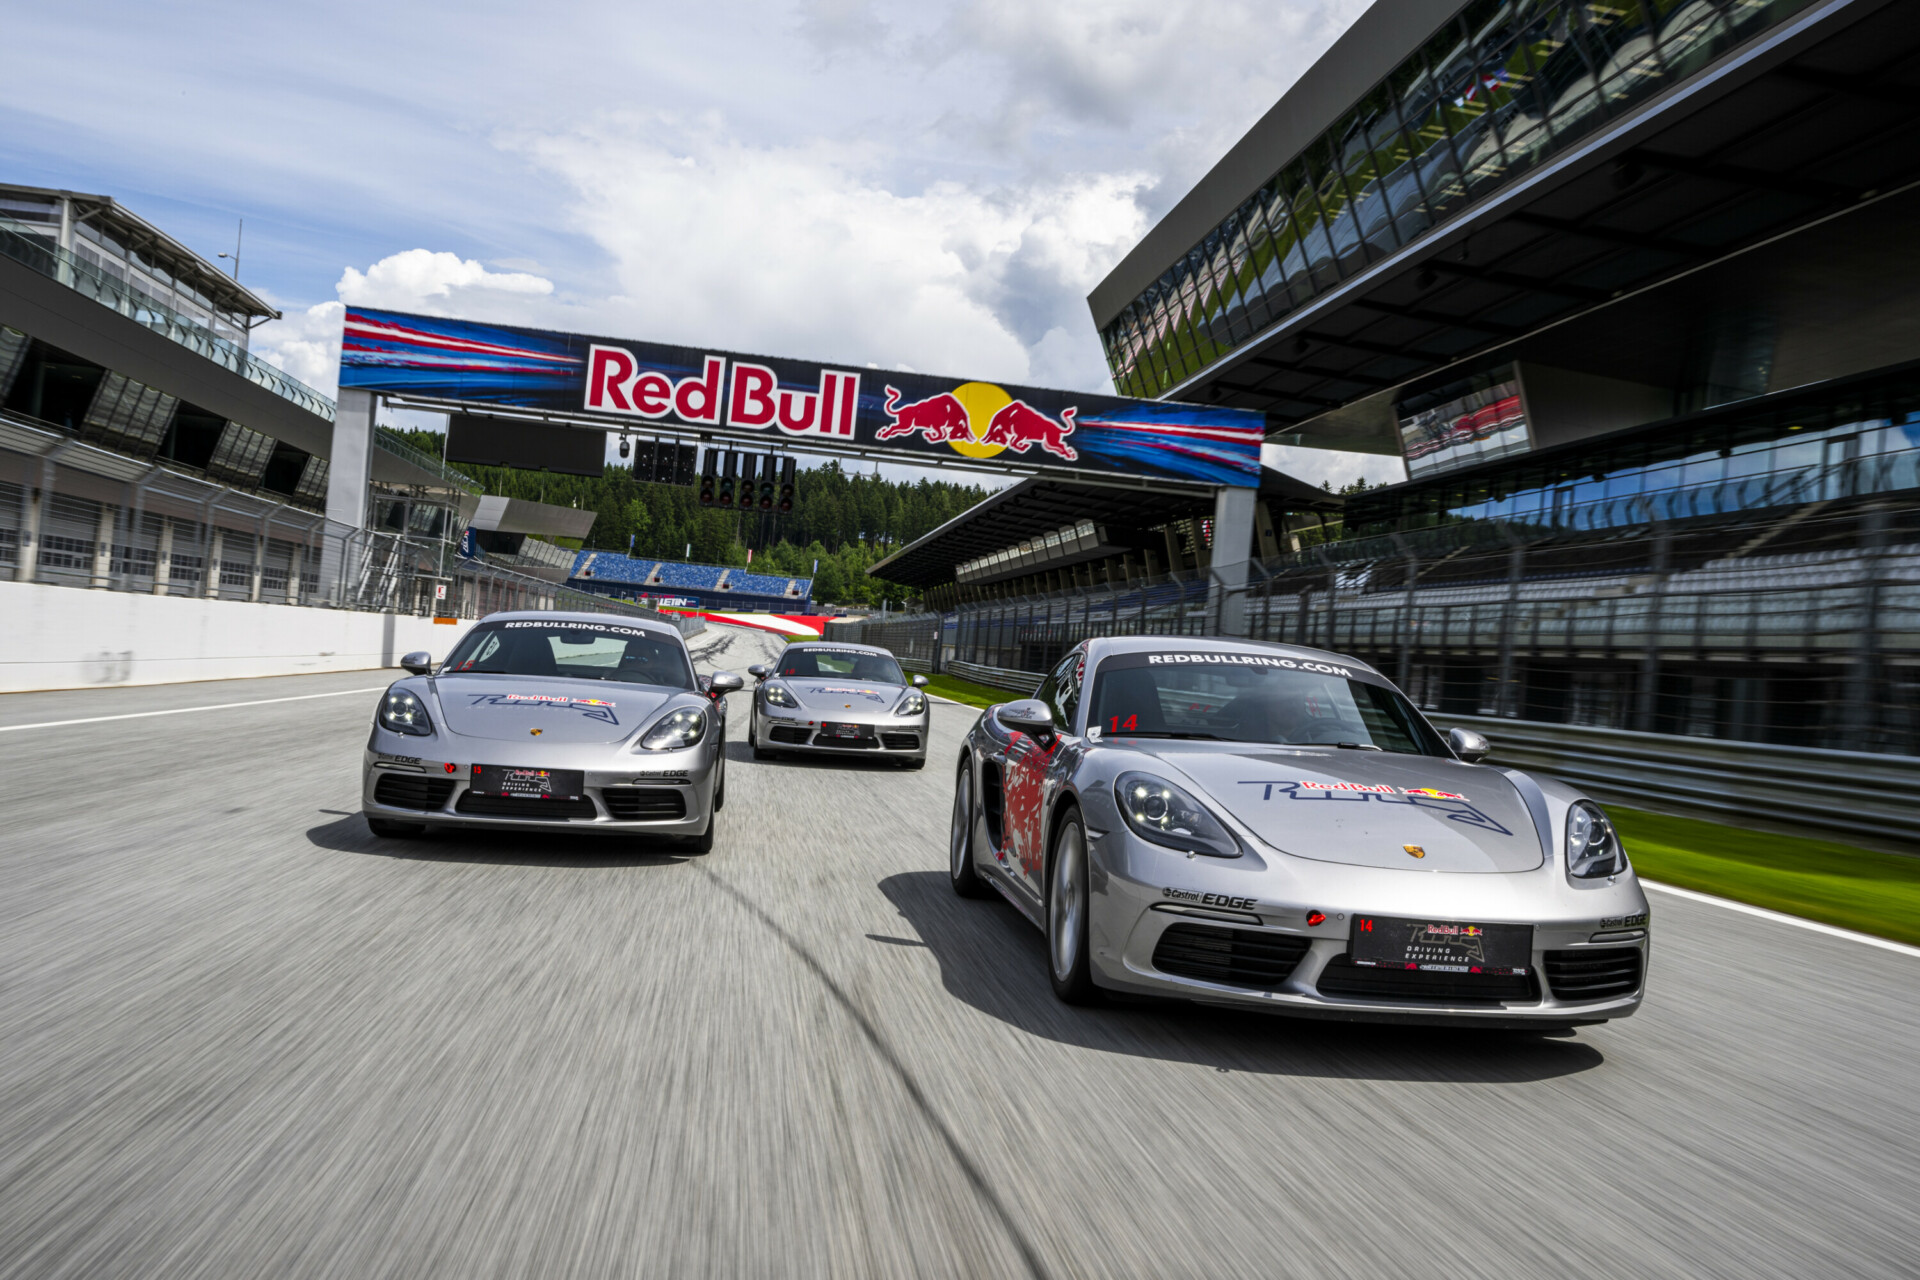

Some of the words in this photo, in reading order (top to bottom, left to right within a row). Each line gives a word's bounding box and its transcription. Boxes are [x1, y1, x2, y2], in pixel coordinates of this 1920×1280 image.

[585, 344, 726, 424] Red
[727, 361, 861, 440] Bull
[505, 621, 646, 637] REDBULLRING.COM
[803, 648, 877, 657] REDBULLRING.COM
[455, 660, 475, 671] 15
[1148, 654, 1353, 679] REDBULLRING.COM
[1109, 714, 1138, 733] 14
[473, 765, 482, 774] 15
[1299, 781, 1349, 791] Red
[1347, 783, 1397, 794] Bull
[1171, 889, 1200, 901] Castrol
[1201, 892, 1258, 911] EDGE
[1359, 919, 1373, 932] 14
[1427, 924, 1443, 934] Red
[1443, 925, 1459, 935] Bull
[1406, 945, 1451, 954] DRIVING
[1404, 953, 1470, 962] EXPERIENCE
